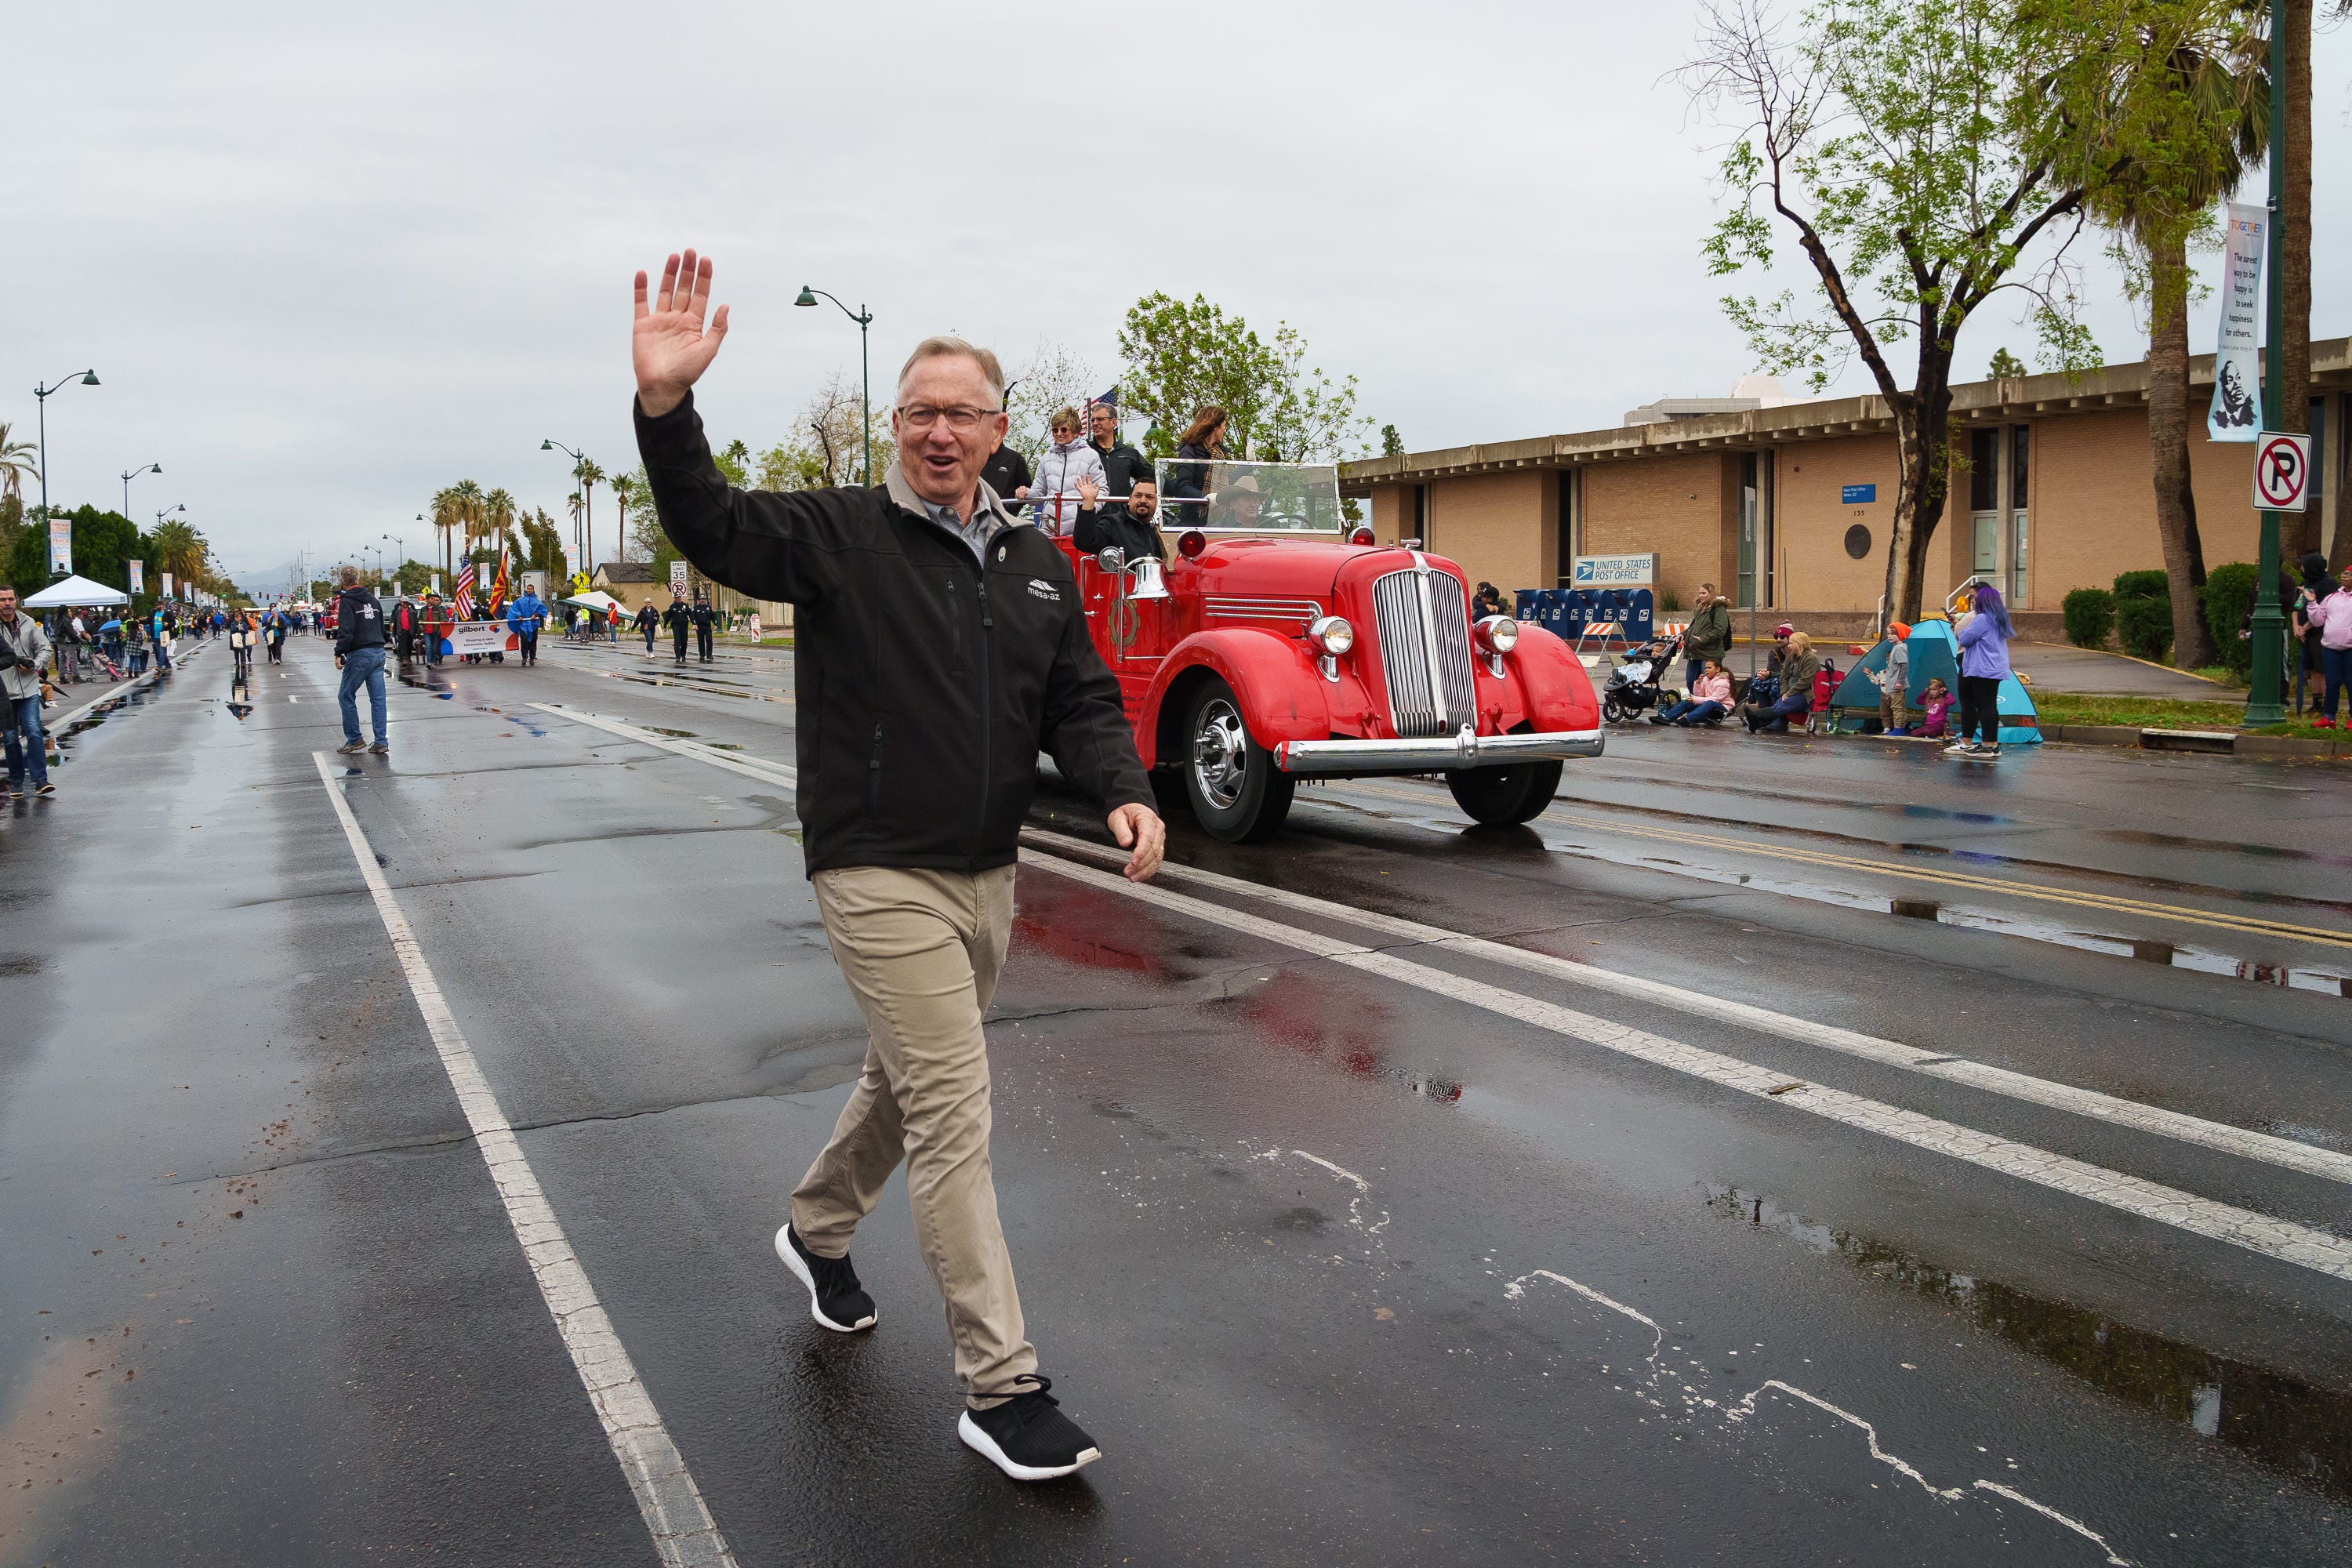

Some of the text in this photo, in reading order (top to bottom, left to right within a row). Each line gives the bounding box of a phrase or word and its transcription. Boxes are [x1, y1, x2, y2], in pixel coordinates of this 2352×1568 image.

[2230, 220, 2263, 234] TOGETHER
[2234, 270, 2242, 279] way
[2249, 270, 2256, 279] be
[2234, 282, 2252, 295] happy is
[2241, 299, 2253, 308] seek
[2228, 312, 2252, 324] happiness
[2233, 328, 2252, 338] others.
[1596, 559, 1651, 570] UNITED STATES
[1595, 570, 1639, 580] POST OFFICE
[458, 626, 485, 634] gilbert
